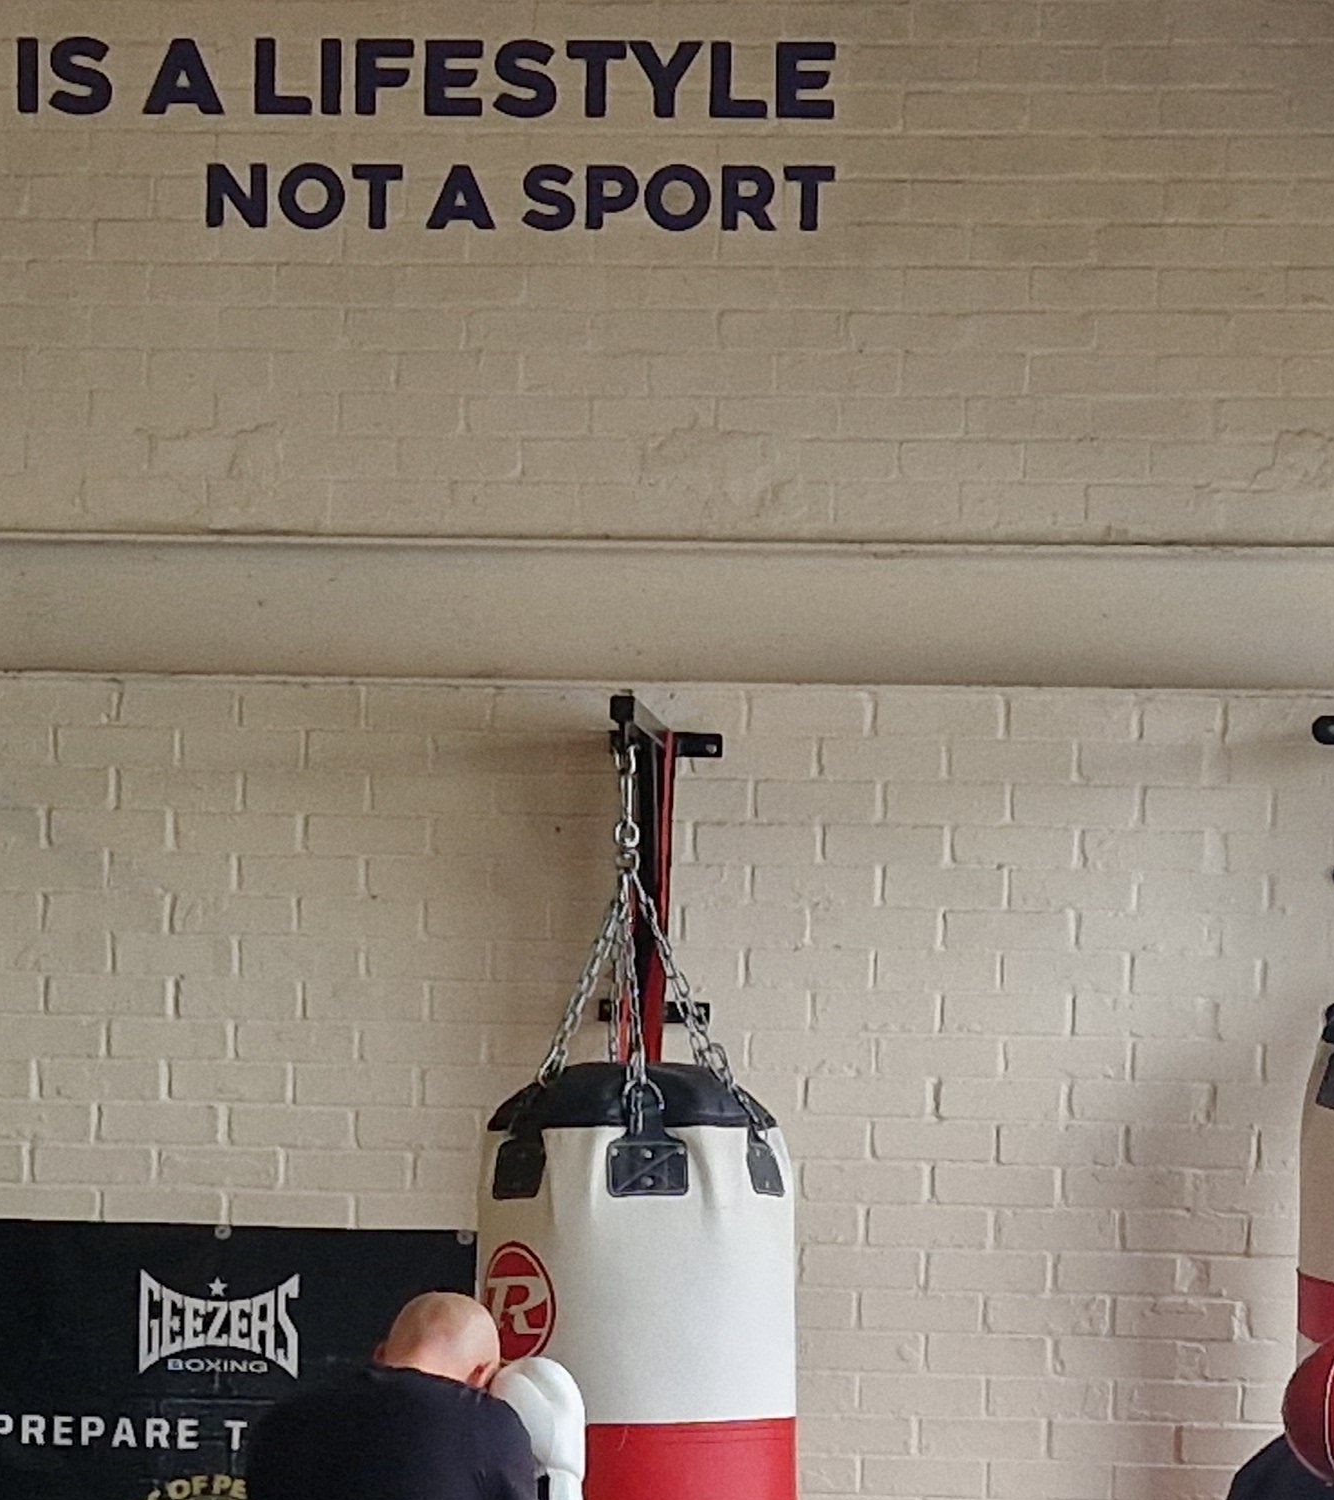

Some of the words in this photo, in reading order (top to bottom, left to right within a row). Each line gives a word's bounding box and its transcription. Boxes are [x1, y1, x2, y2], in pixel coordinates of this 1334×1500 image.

[17, 37, 112, 115] IS
[143, 39, 224, 114] A
[254, 38, 836, 119] LIFESTYLE
[206, 163, 403, 229] NOT
[426, 165, 495, 229] A
[522, 164, 835, 231] SPORT
[139, 1268, 300, 1380] GEEZERS
[167, 1357, 269, 1374] BOXING
[223, 1419, 249, 1452] T
[167, 1474, 209, 1500] OF
[212, 1474, 248, 1500] PE
